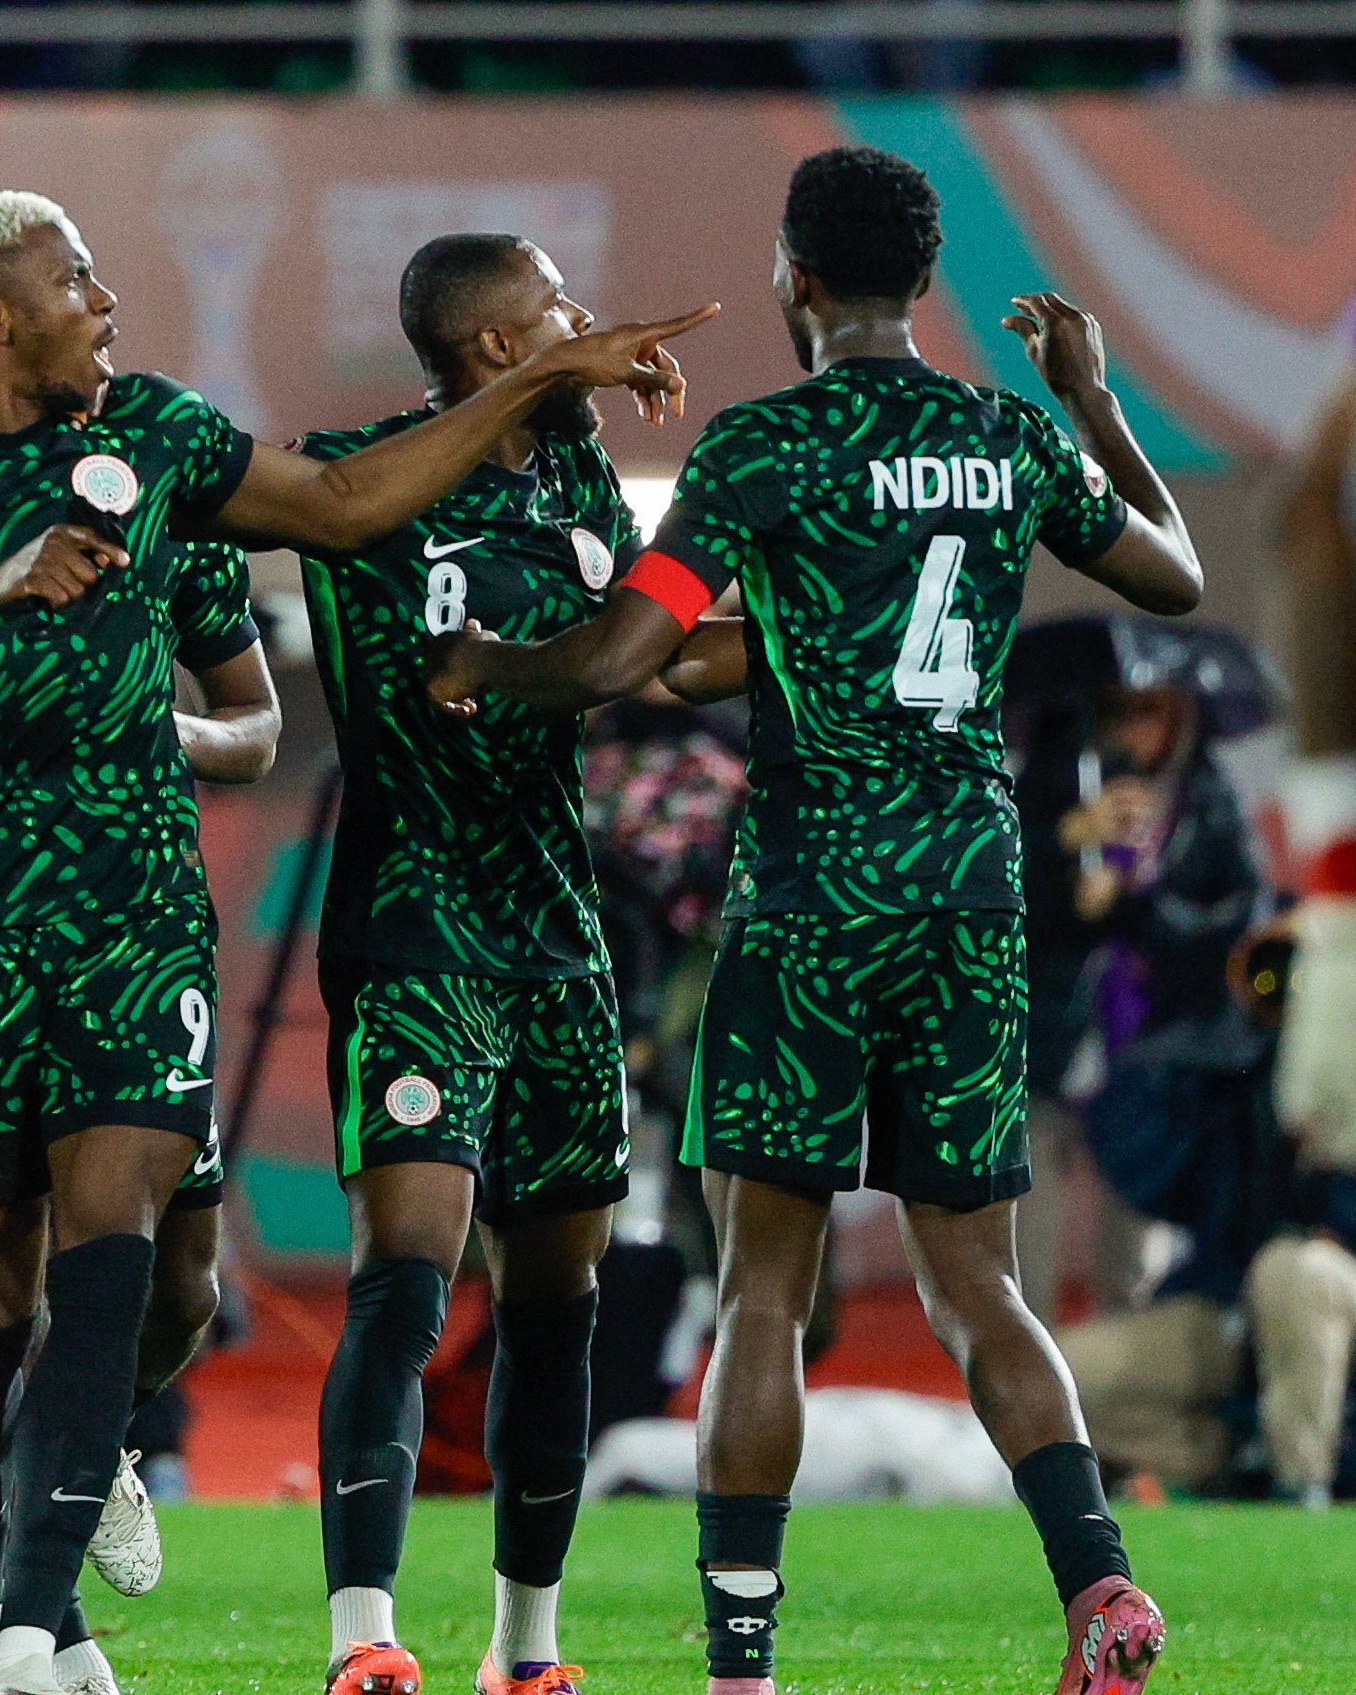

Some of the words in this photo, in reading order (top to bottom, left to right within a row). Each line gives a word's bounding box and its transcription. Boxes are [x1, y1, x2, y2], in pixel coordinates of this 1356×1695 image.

[868, 456, 1013, 511] NDIDI
[425, 561, 468, 638] 8
[892, 535, 980, 733] 4
[179, 987, 210, 1066] 9
